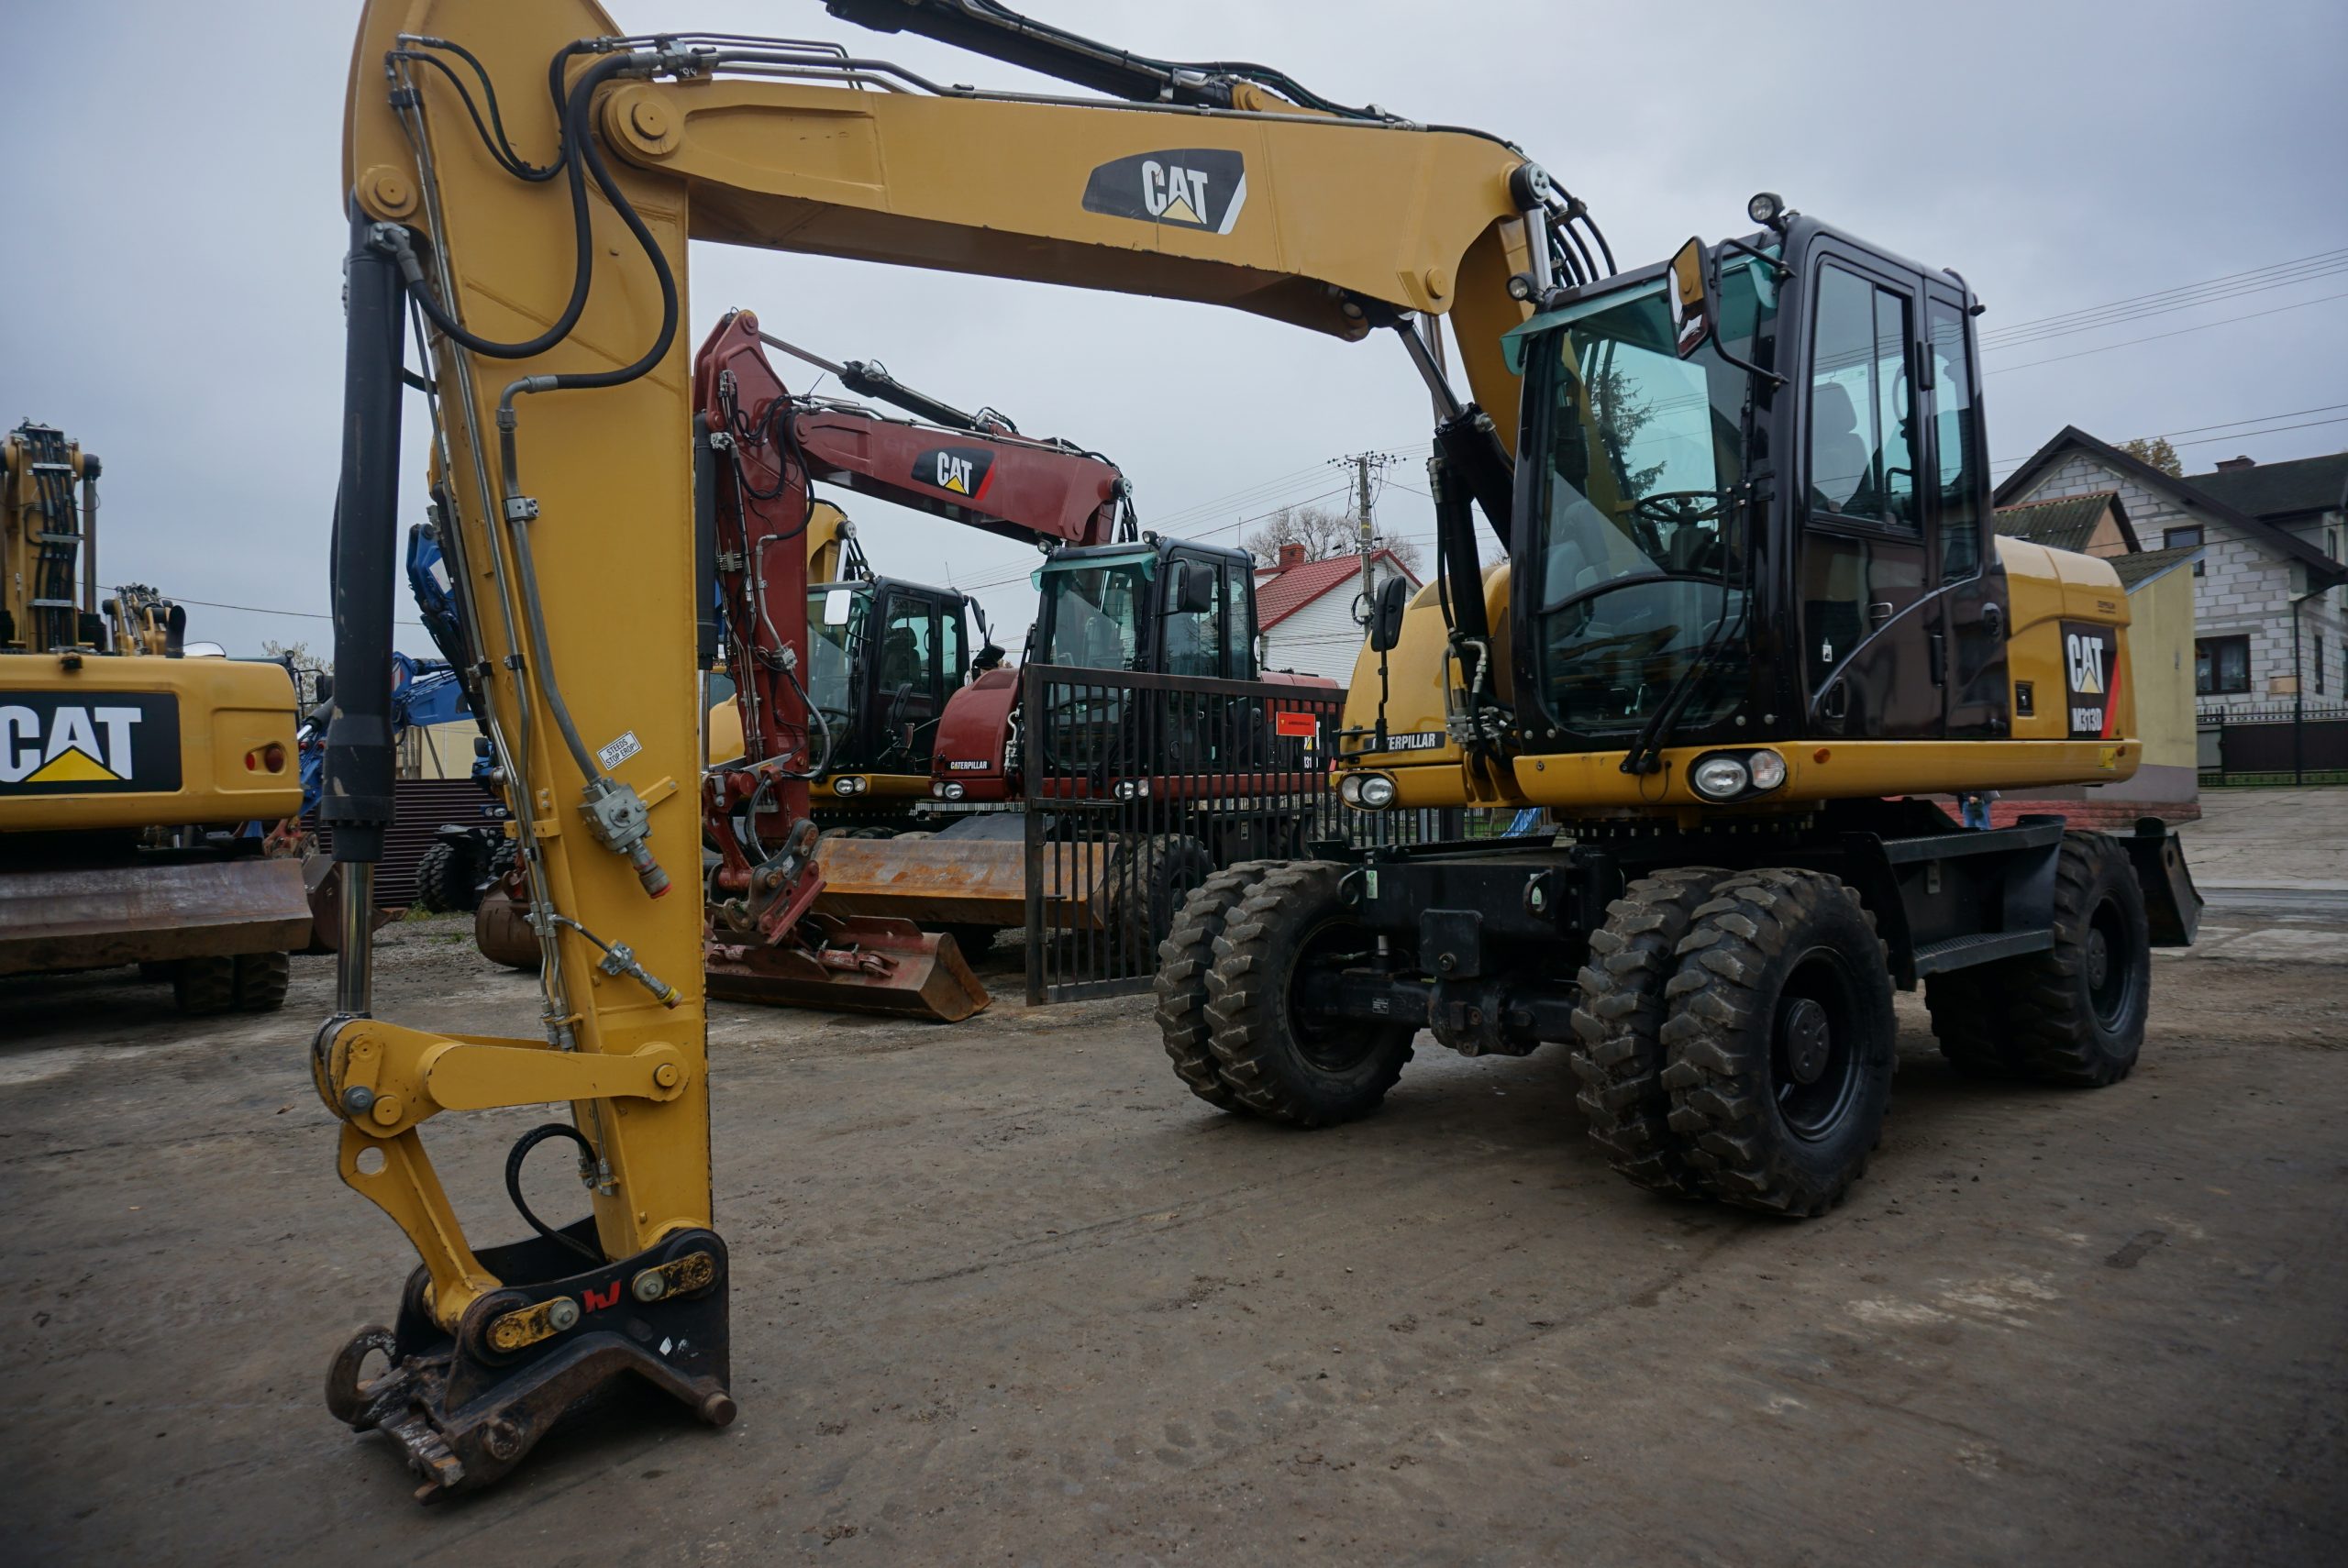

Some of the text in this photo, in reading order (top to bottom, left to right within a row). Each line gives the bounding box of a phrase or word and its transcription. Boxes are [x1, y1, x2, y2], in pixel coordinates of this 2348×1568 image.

[1142, 160, 1208, 224] CAT
[937, 451, 972, 494] CAT
[2067, 634, 2104, 694] CAT
[2072, 708, 2103, 731] M313D
[0, 705, 142, 782] CAT
[606, 739, 628, 756] STEEDS
[1372, 734, 1436, 750] TERPILLAR
[605, 753, 620, 767] STOP
[950, 761, 988, 769] CATERPILLAR
